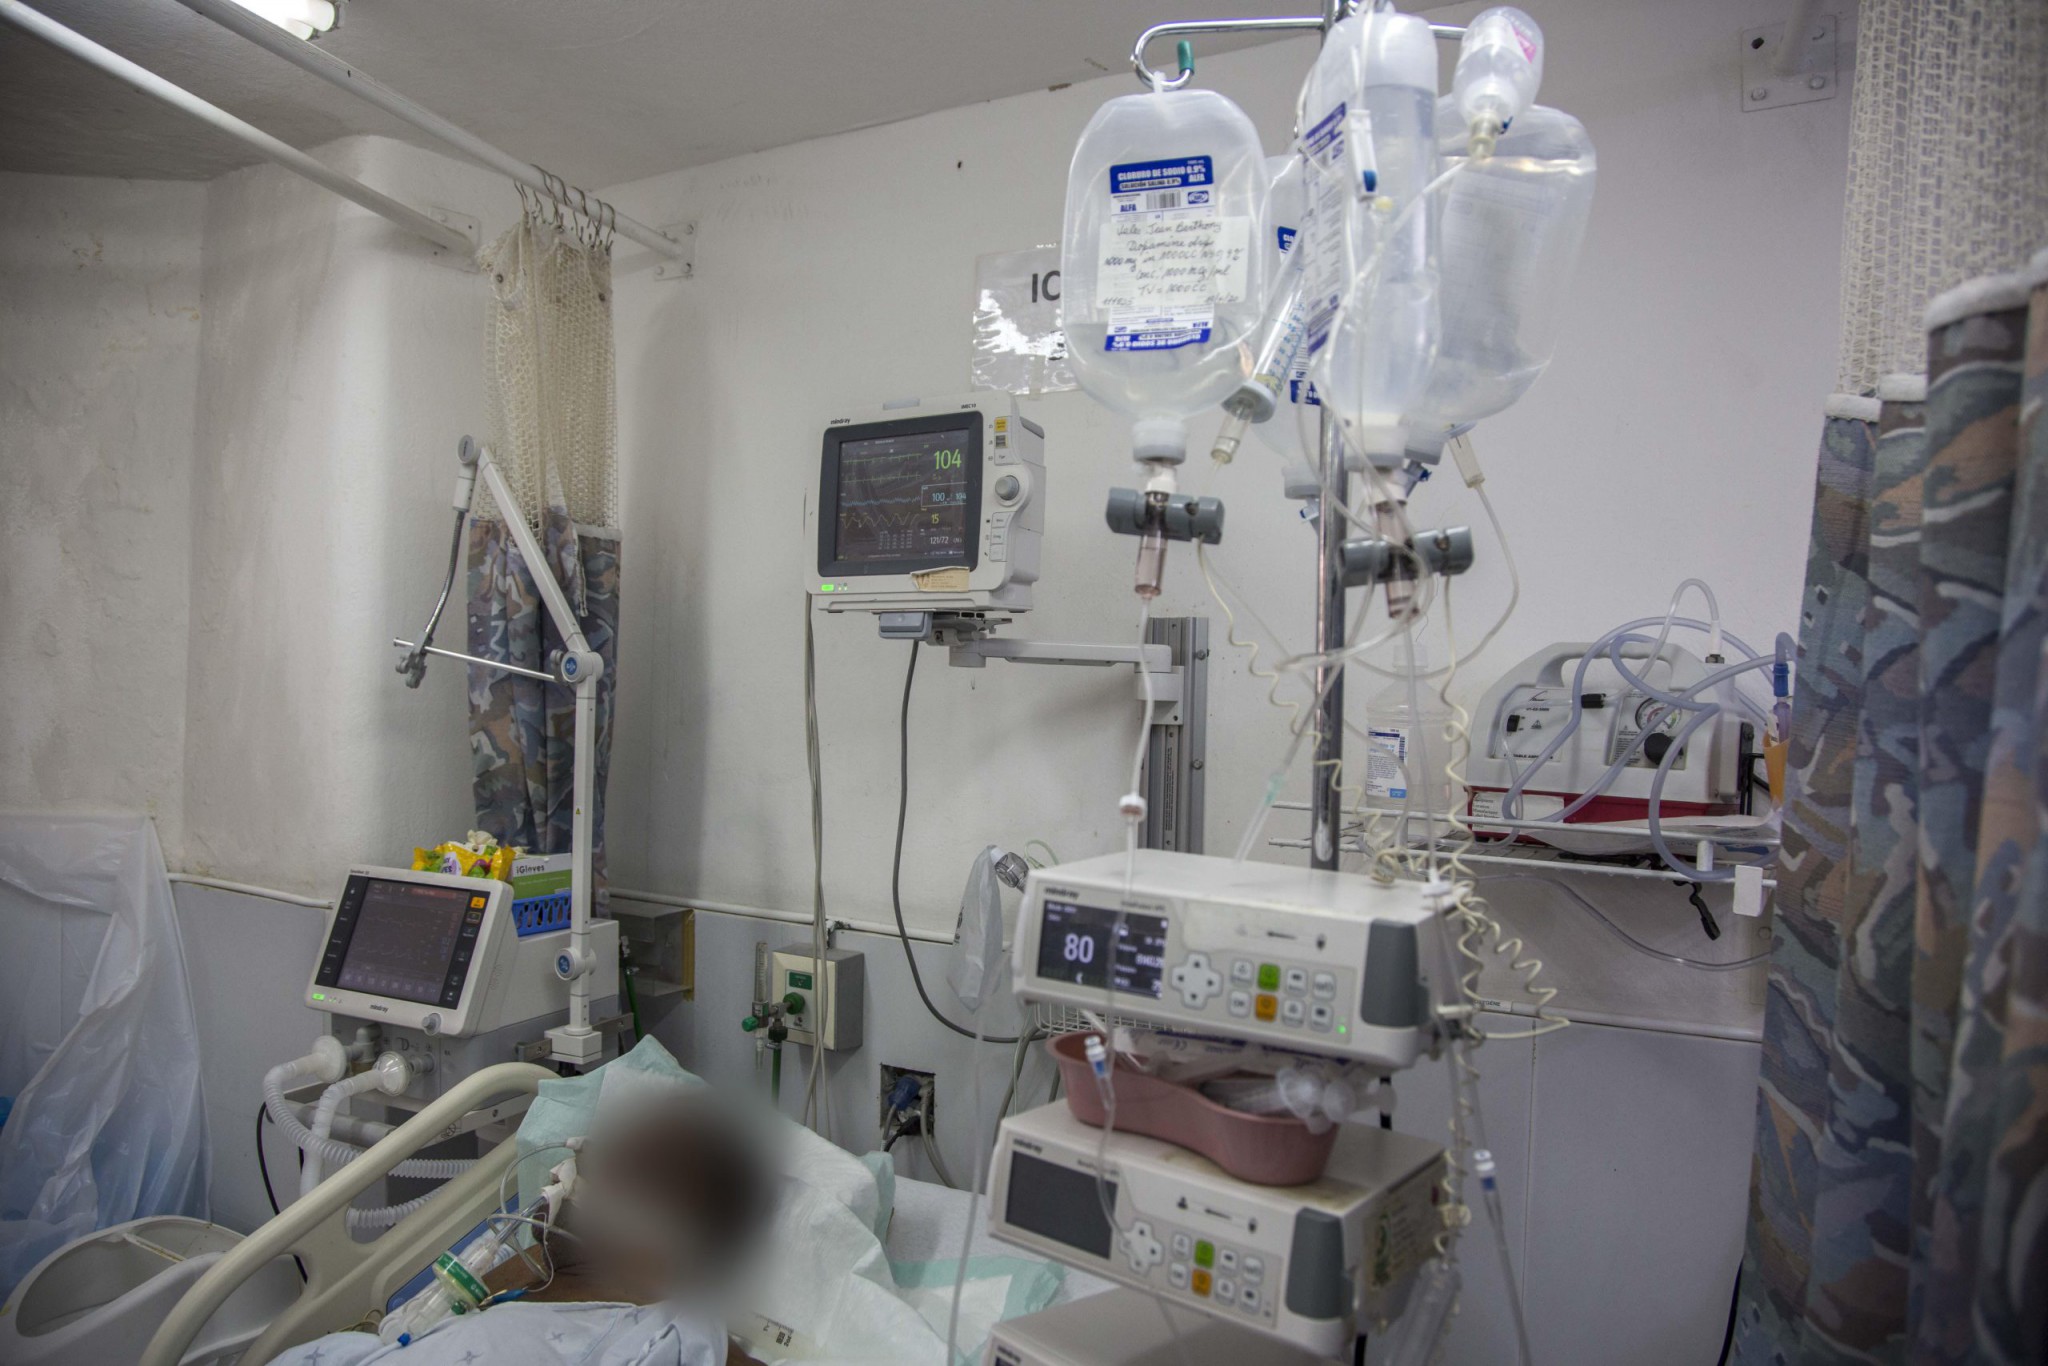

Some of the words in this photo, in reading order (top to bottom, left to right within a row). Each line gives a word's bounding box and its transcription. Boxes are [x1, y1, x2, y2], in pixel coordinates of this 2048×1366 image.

[1152, 168, 1162, 177] DE
[1162, 166, 1185, 177] SODIO
[1186, 165, 1206, 174] 0.9%
[1188, 173, 1206, 183] ALFA
[1120, 203, 1137, 212] ALFA
[934, 448, 962, 470] 104
[932, 492, 945, 502] 100
[931, 513, 940, 524] 15
[930, 536, 949, 545] 121/72
[516, 864, 545, 874] iGloves
[1064, 933, 1095, 964] 80
